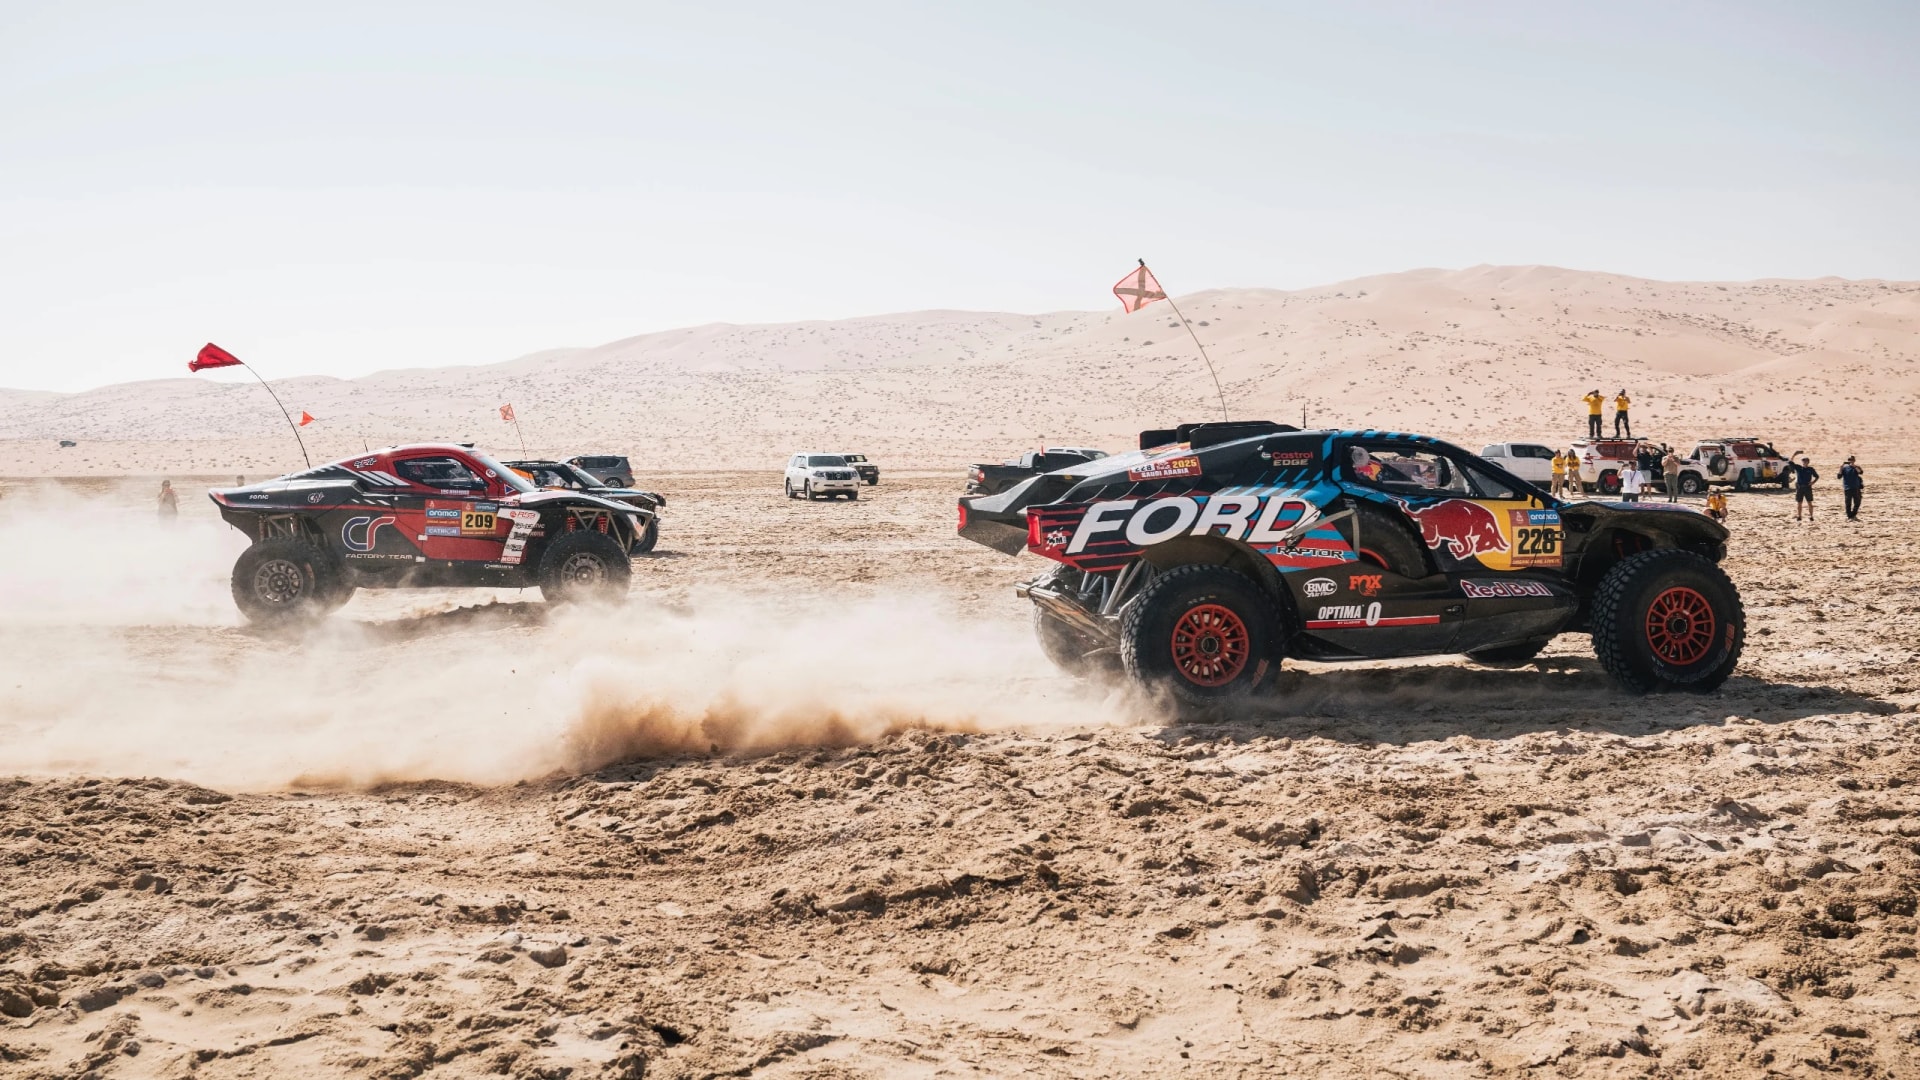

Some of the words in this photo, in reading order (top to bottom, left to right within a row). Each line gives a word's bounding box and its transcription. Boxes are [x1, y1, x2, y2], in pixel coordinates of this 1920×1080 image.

[1172, 459, 1197, 469] 2025
[1163, 468, 1189, 476] ARABIA
[465, 514, 493, 528] 209
[1065, 496, 1321, 554] FORD
[1517, 528, 1556, 554] 228
[1276, 546, 1346, 562] RAPTOR
[1307, 582, 1335, 592] BMC
[1349, 575, 1383, 590] FOX
[1460, 579, 1512, 598] Red
[1502, 582, 1554, 597] Bull
[1318, 605, 1362, 620] OPTIMA
